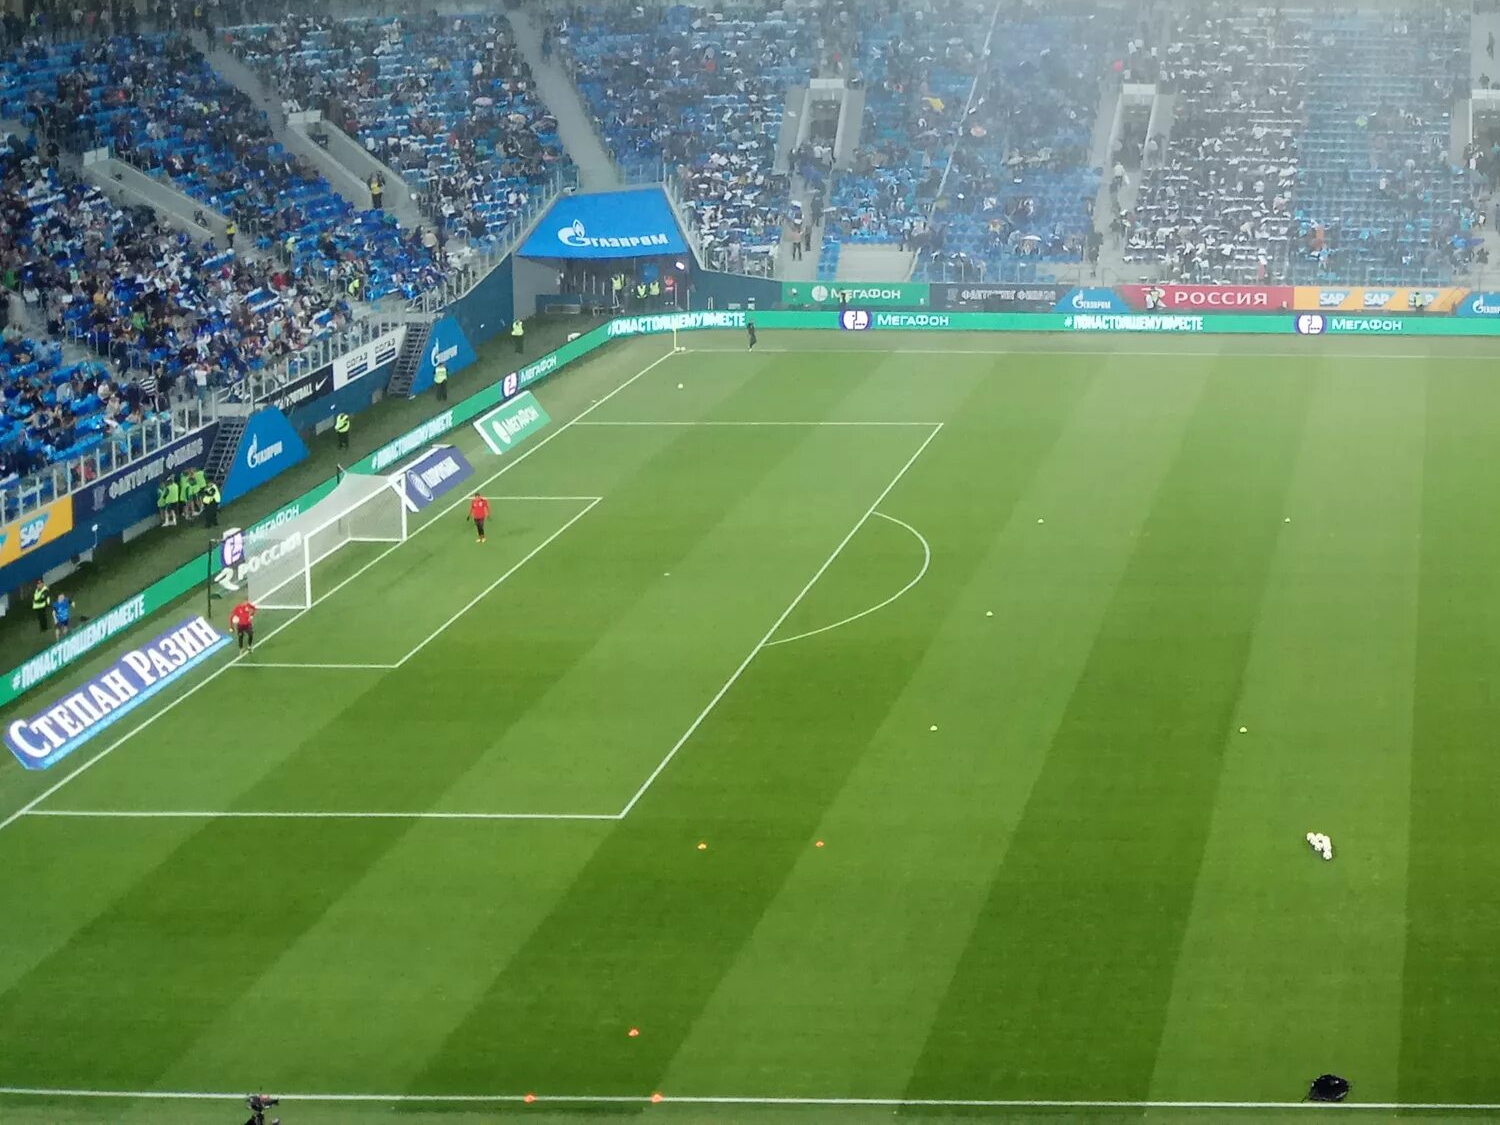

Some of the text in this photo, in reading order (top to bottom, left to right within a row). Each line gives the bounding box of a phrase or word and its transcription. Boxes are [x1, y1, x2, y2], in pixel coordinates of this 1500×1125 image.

[1174, 291, 1267, 305] РОССИЯ
[1320, 291, 1346, 306] SAP
[1364, 291, 1390, 306] SAP
[877, 314, 949, 326] МЕГАФОН
[1331, 318, 1402, 331] МЕГАФОН
[20, 519, 45, 548] SAP
[9, 616, 222, 759] СТЕПАН РАЗИН
